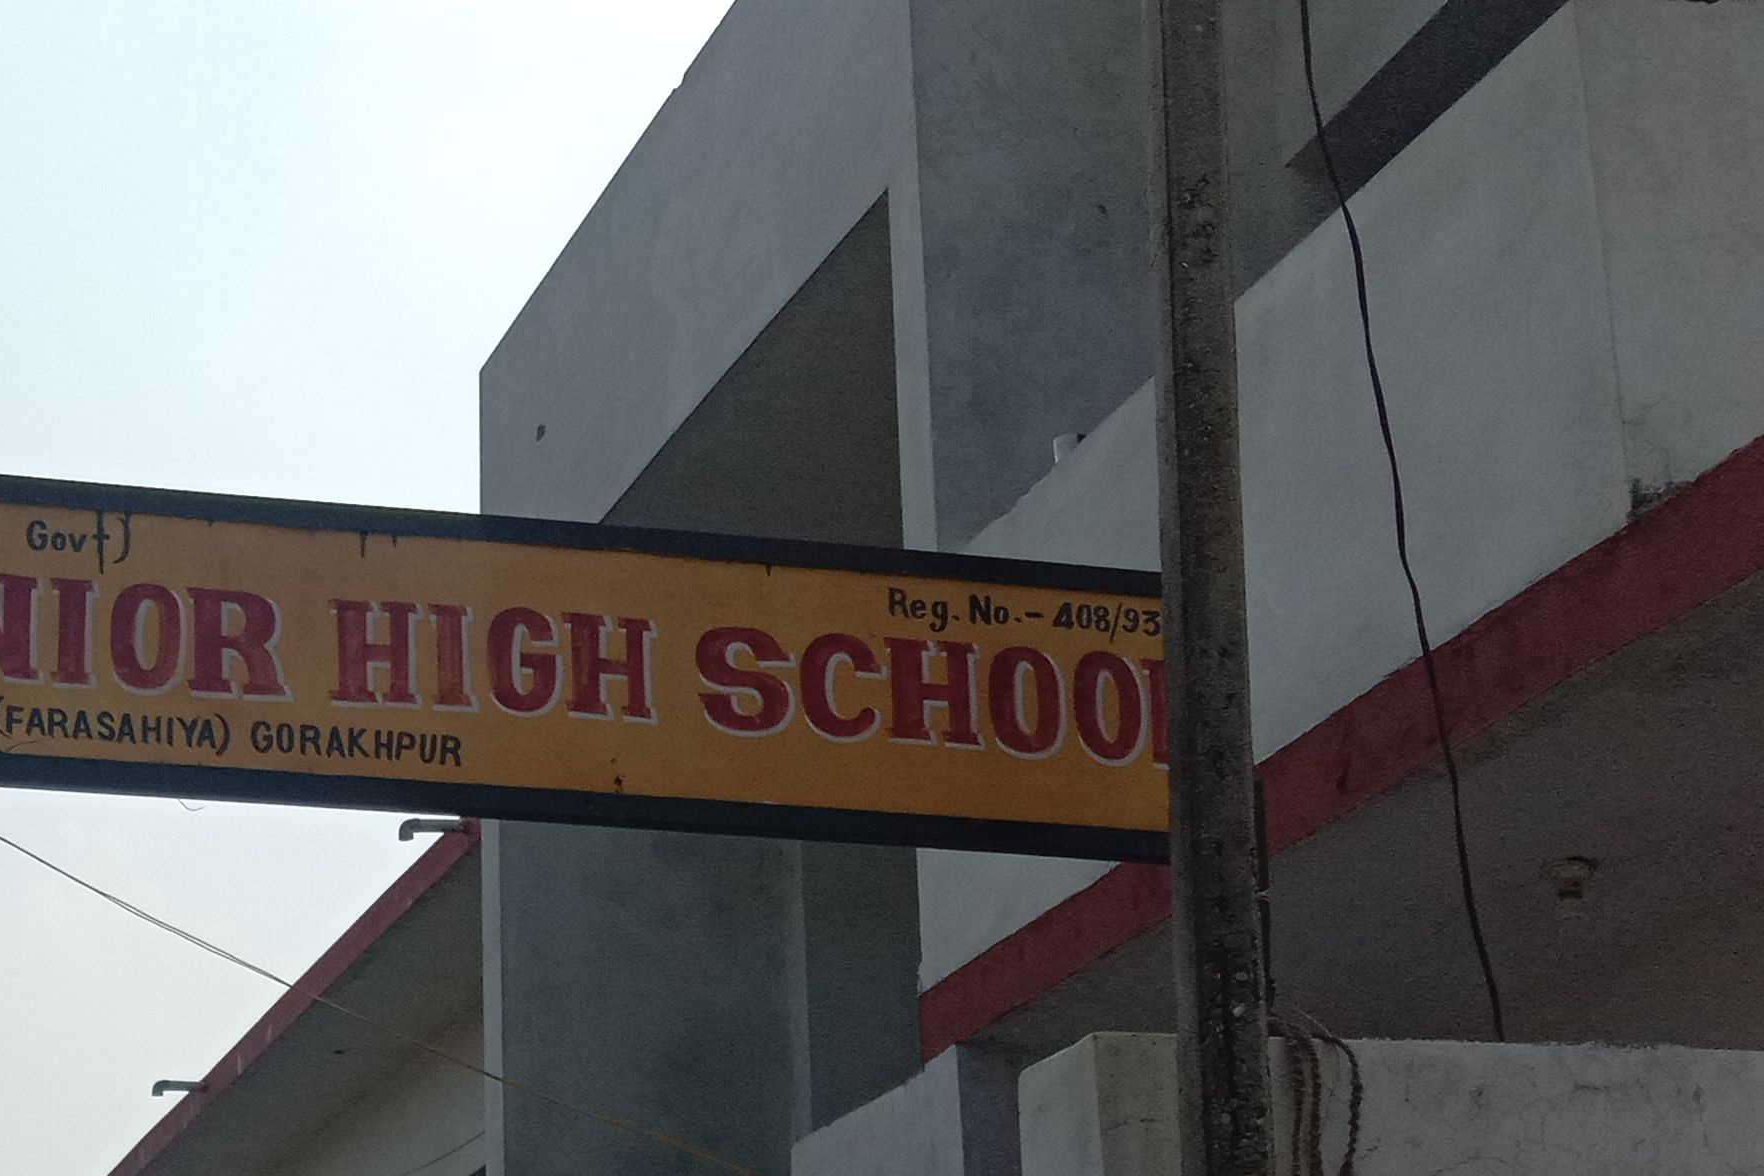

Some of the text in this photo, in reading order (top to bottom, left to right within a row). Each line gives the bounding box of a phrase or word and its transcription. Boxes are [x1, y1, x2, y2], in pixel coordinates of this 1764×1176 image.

[887, 587, 959, 630] Reg.
[330, 598, 656, 724] HIGH
[251, 720, 461, 768] GORAKHPUR
